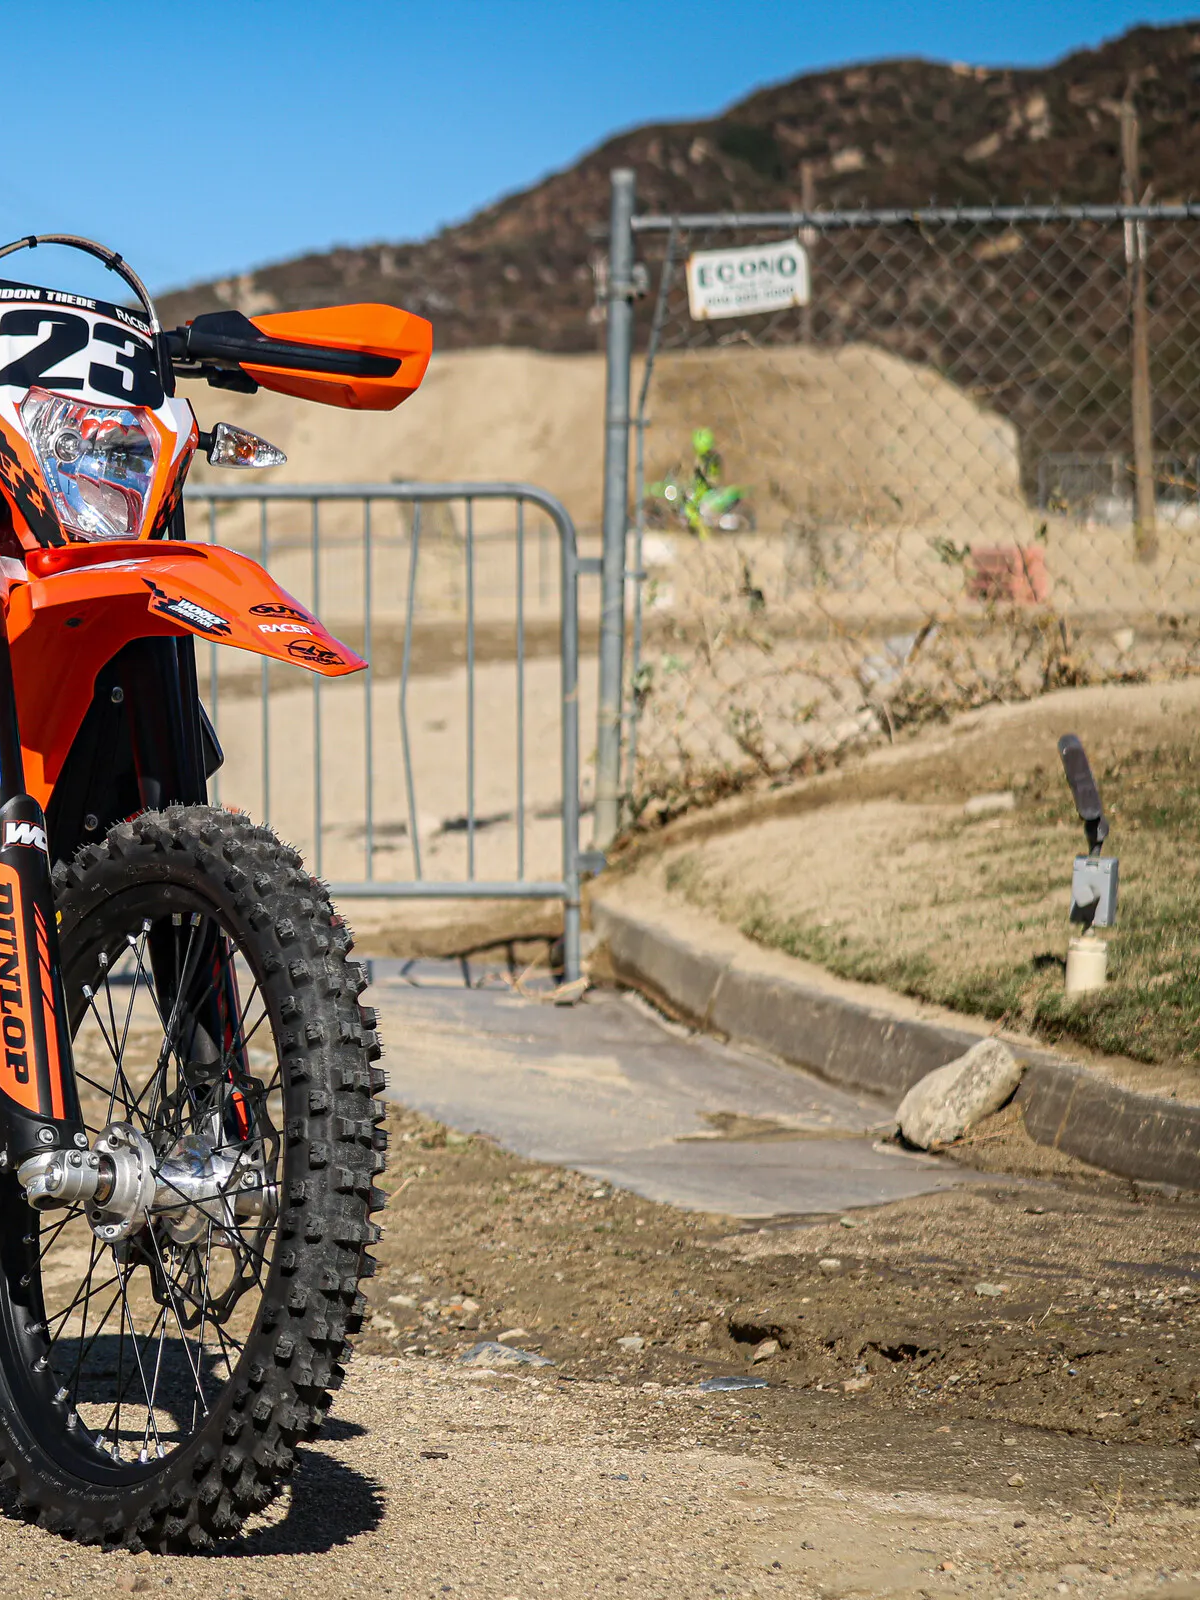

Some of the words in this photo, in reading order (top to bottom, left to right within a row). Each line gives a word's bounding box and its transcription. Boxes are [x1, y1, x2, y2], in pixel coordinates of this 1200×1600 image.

[698, 254, 797, 288] ECONO
[46, 290, 96, 310] THEDE
[177, 600, 229, 625] WORKS
